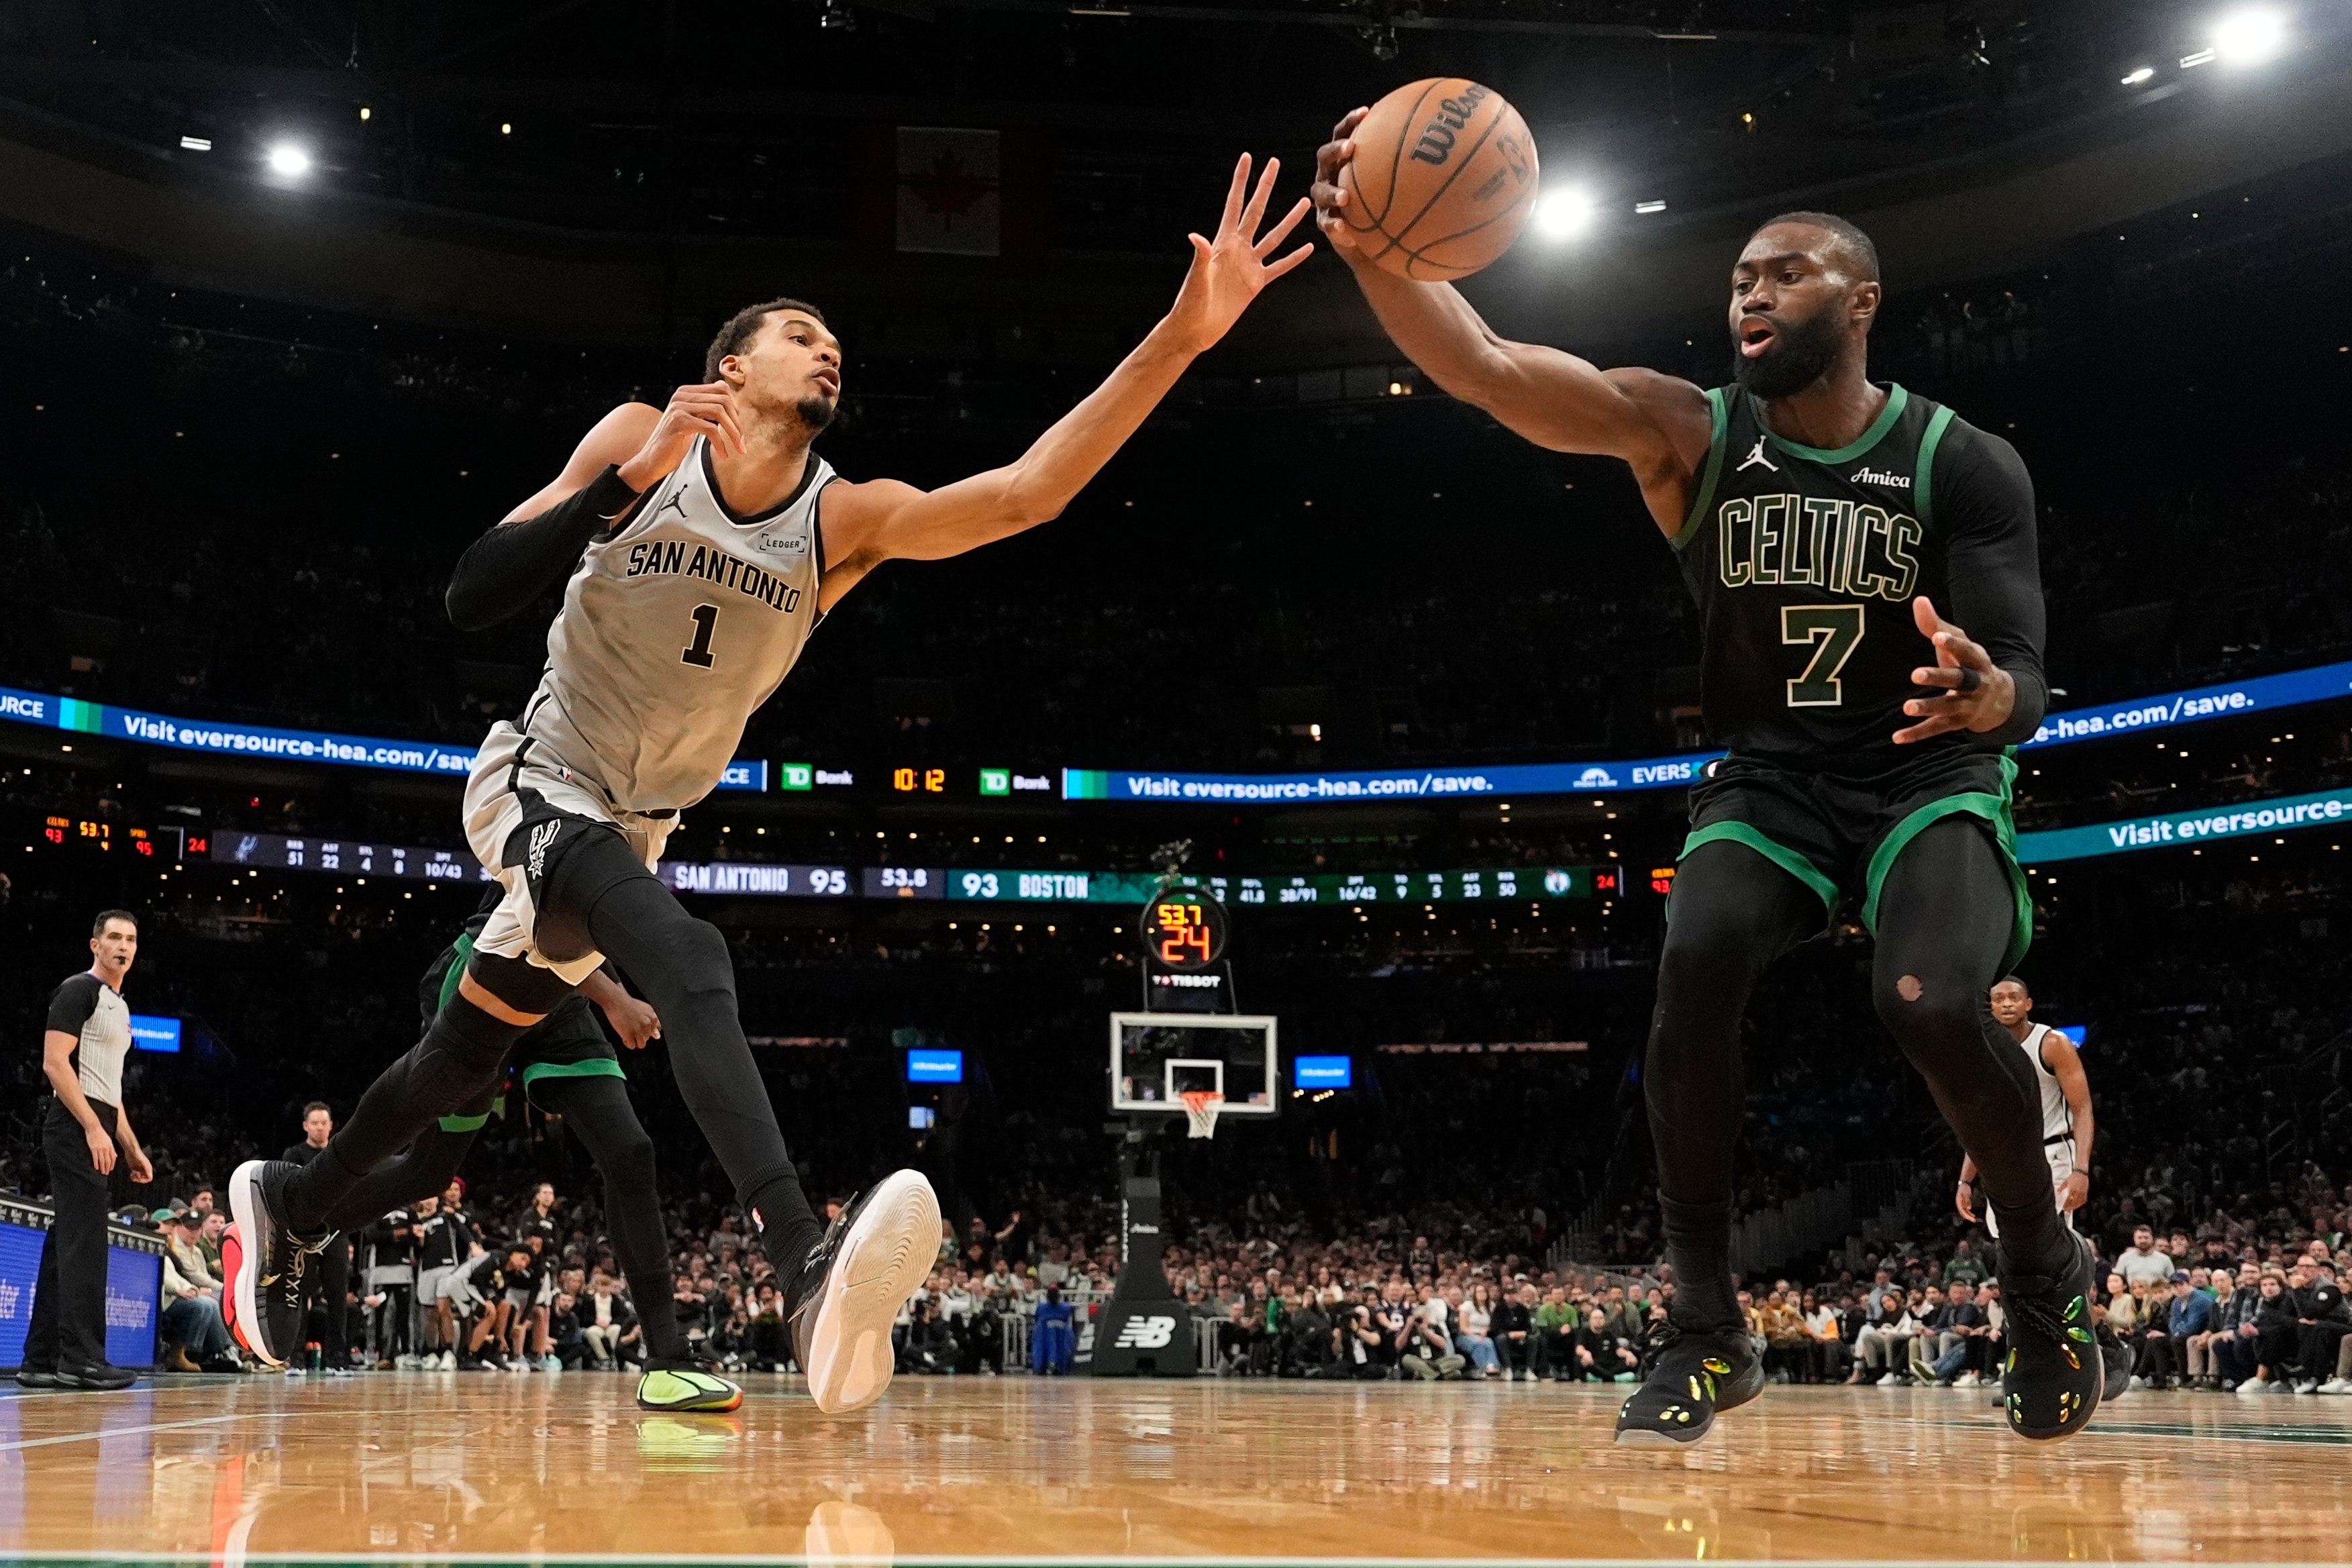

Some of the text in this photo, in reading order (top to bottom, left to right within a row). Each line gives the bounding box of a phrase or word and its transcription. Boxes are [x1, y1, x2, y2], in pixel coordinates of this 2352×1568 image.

[1851, 467, 1910, 488] Amica
[766, 538, 800, 549] LEDGER
[1719, 493, 1923, 602] CELTICS
[626, 541, 802, 615] SAN ANTONIO
[679, 603, 721, 670] 1
[1781, 604, 1865, 707] 7
[124, 715, 176, 741] Visit
[815, 770, 853, 785] Bank
[1013, 775, 1050, 790] Bank
[1128, 774, 1493, 799] Visit eversource-hea.com/save.
[46, 828, 62, 843] 93
[2109, 820, 2173, 847] Visit
[136, 841, 152, 855] 95
[189, 838, 206, 852] 24
[321, 854, 340, 869] 22
[361, 857, 371, 872] 4
[425, 862, 462, 880] 10/43
[675, 866, 788, 892] SAN ANTONIO
[809, 869, 847, 894] 95
[880, 868, 927, 888] 53.8
[962, 872, 999, 898] 93
[1019, 874, 1088, 898] BOSTON
[1596, 875, 1615, 889] 24
[1652, 880, 1670, 893] 93
[1158, 904, 1202, 926] 53.7
[1162, 926, 1210, 961] 24
[1170, 975, 1221, 988] TISSOT
